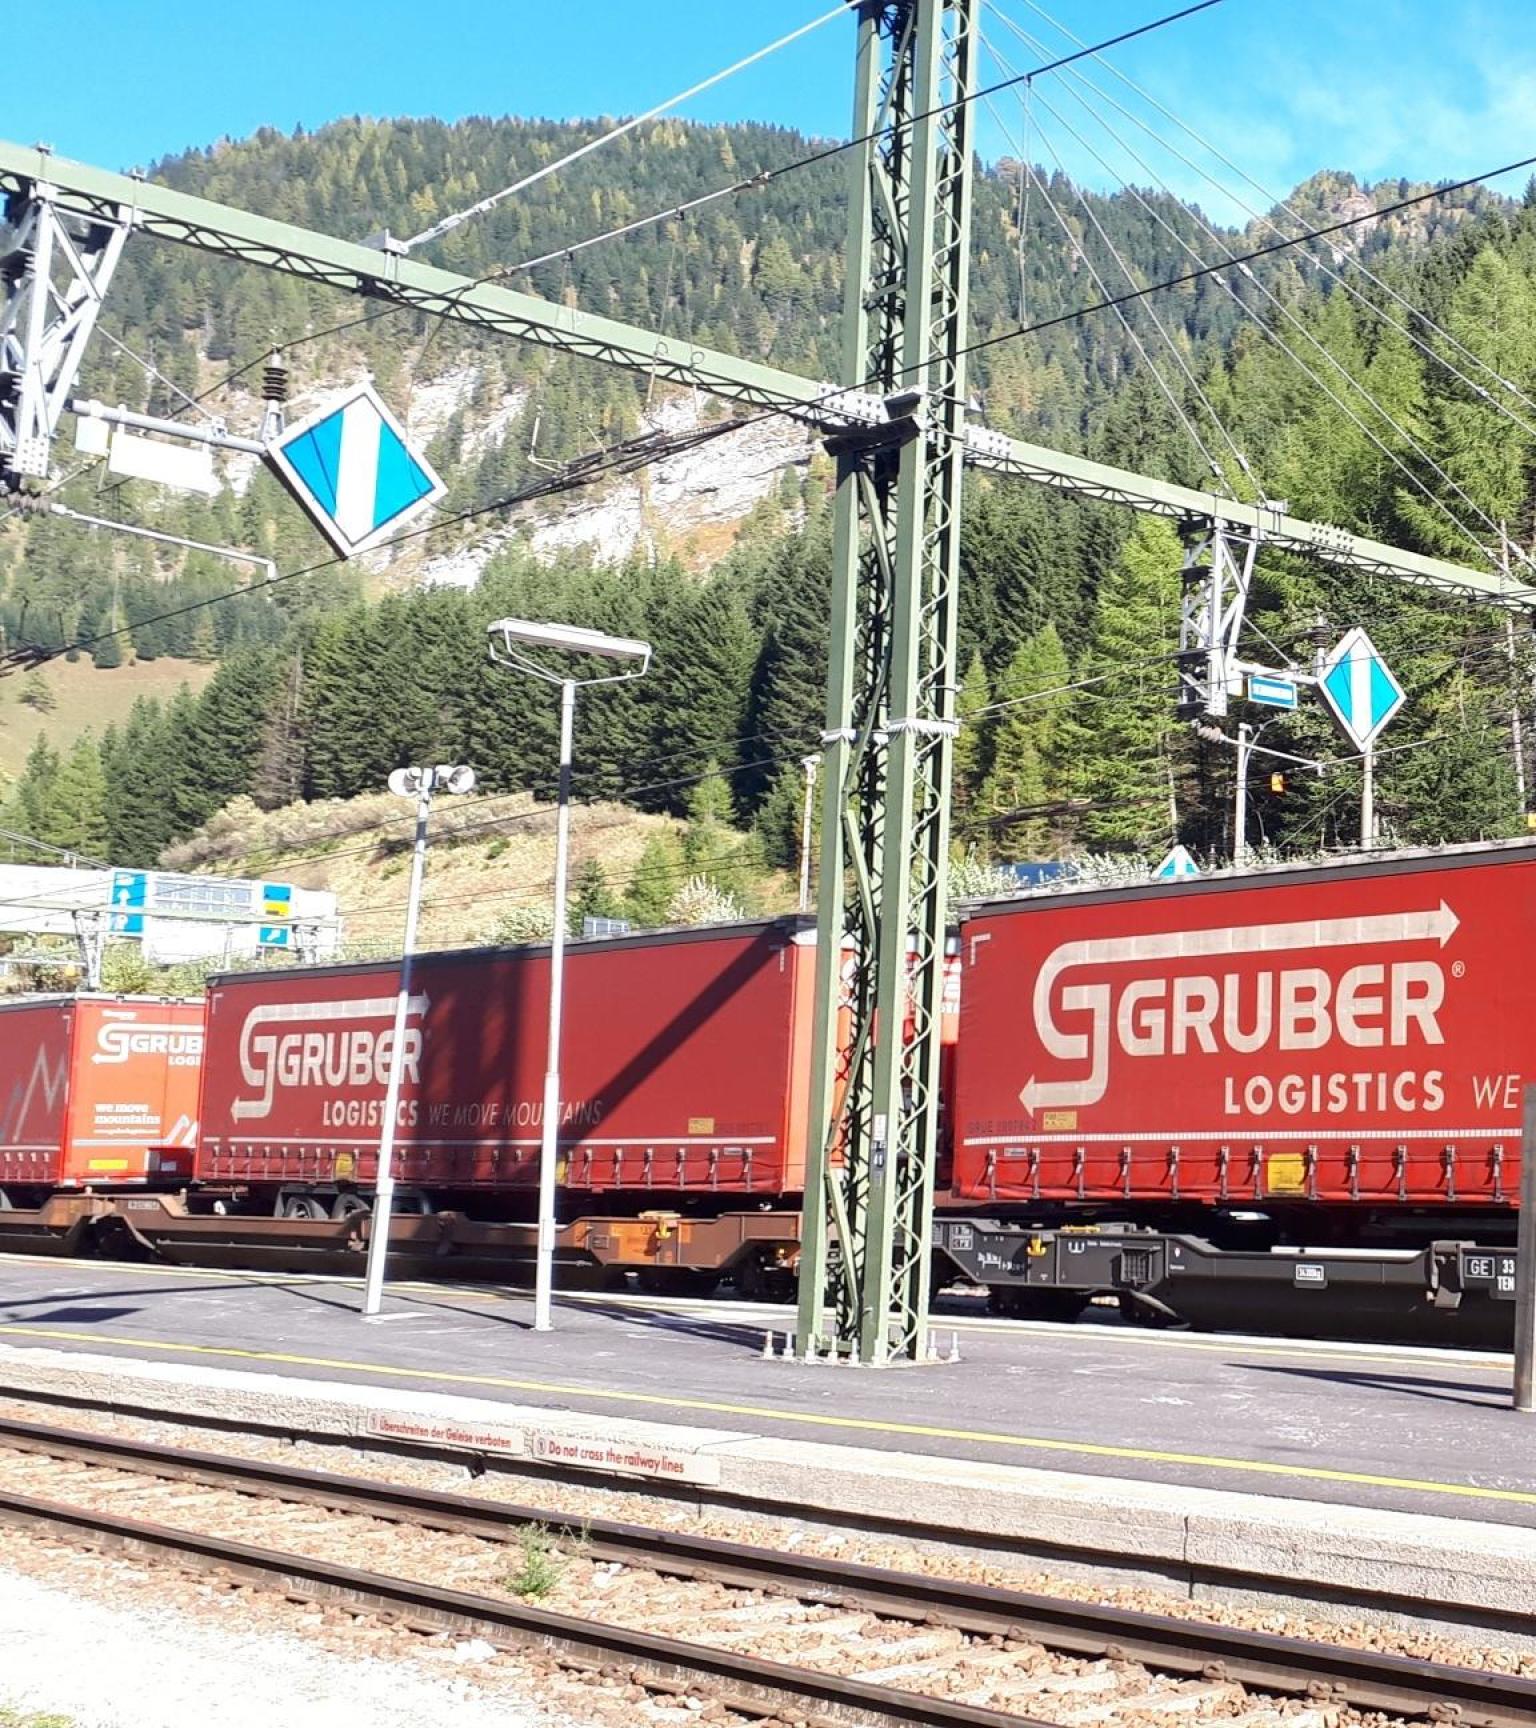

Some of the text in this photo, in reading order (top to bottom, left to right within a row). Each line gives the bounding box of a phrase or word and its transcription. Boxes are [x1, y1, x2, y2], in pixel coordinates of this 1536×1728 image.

[1117, 961, 1445, 1056] GRUBER
[1223, 1071, 1445, 1115] LOGISTICS
[1472, 1074, 1521, 1110] WE
[323, 1100, 418, 1127] LOGISTCS
[502, 1100, 603, 1127] MOUTAINS
[1471, 1260, 1489, 1275] GE
[1502, 1260, 1515, 1274] 33
[1497, 1276, 1515, 1291] TEN
[549, 1440, 685, 1473] Do not cross the railway lines
